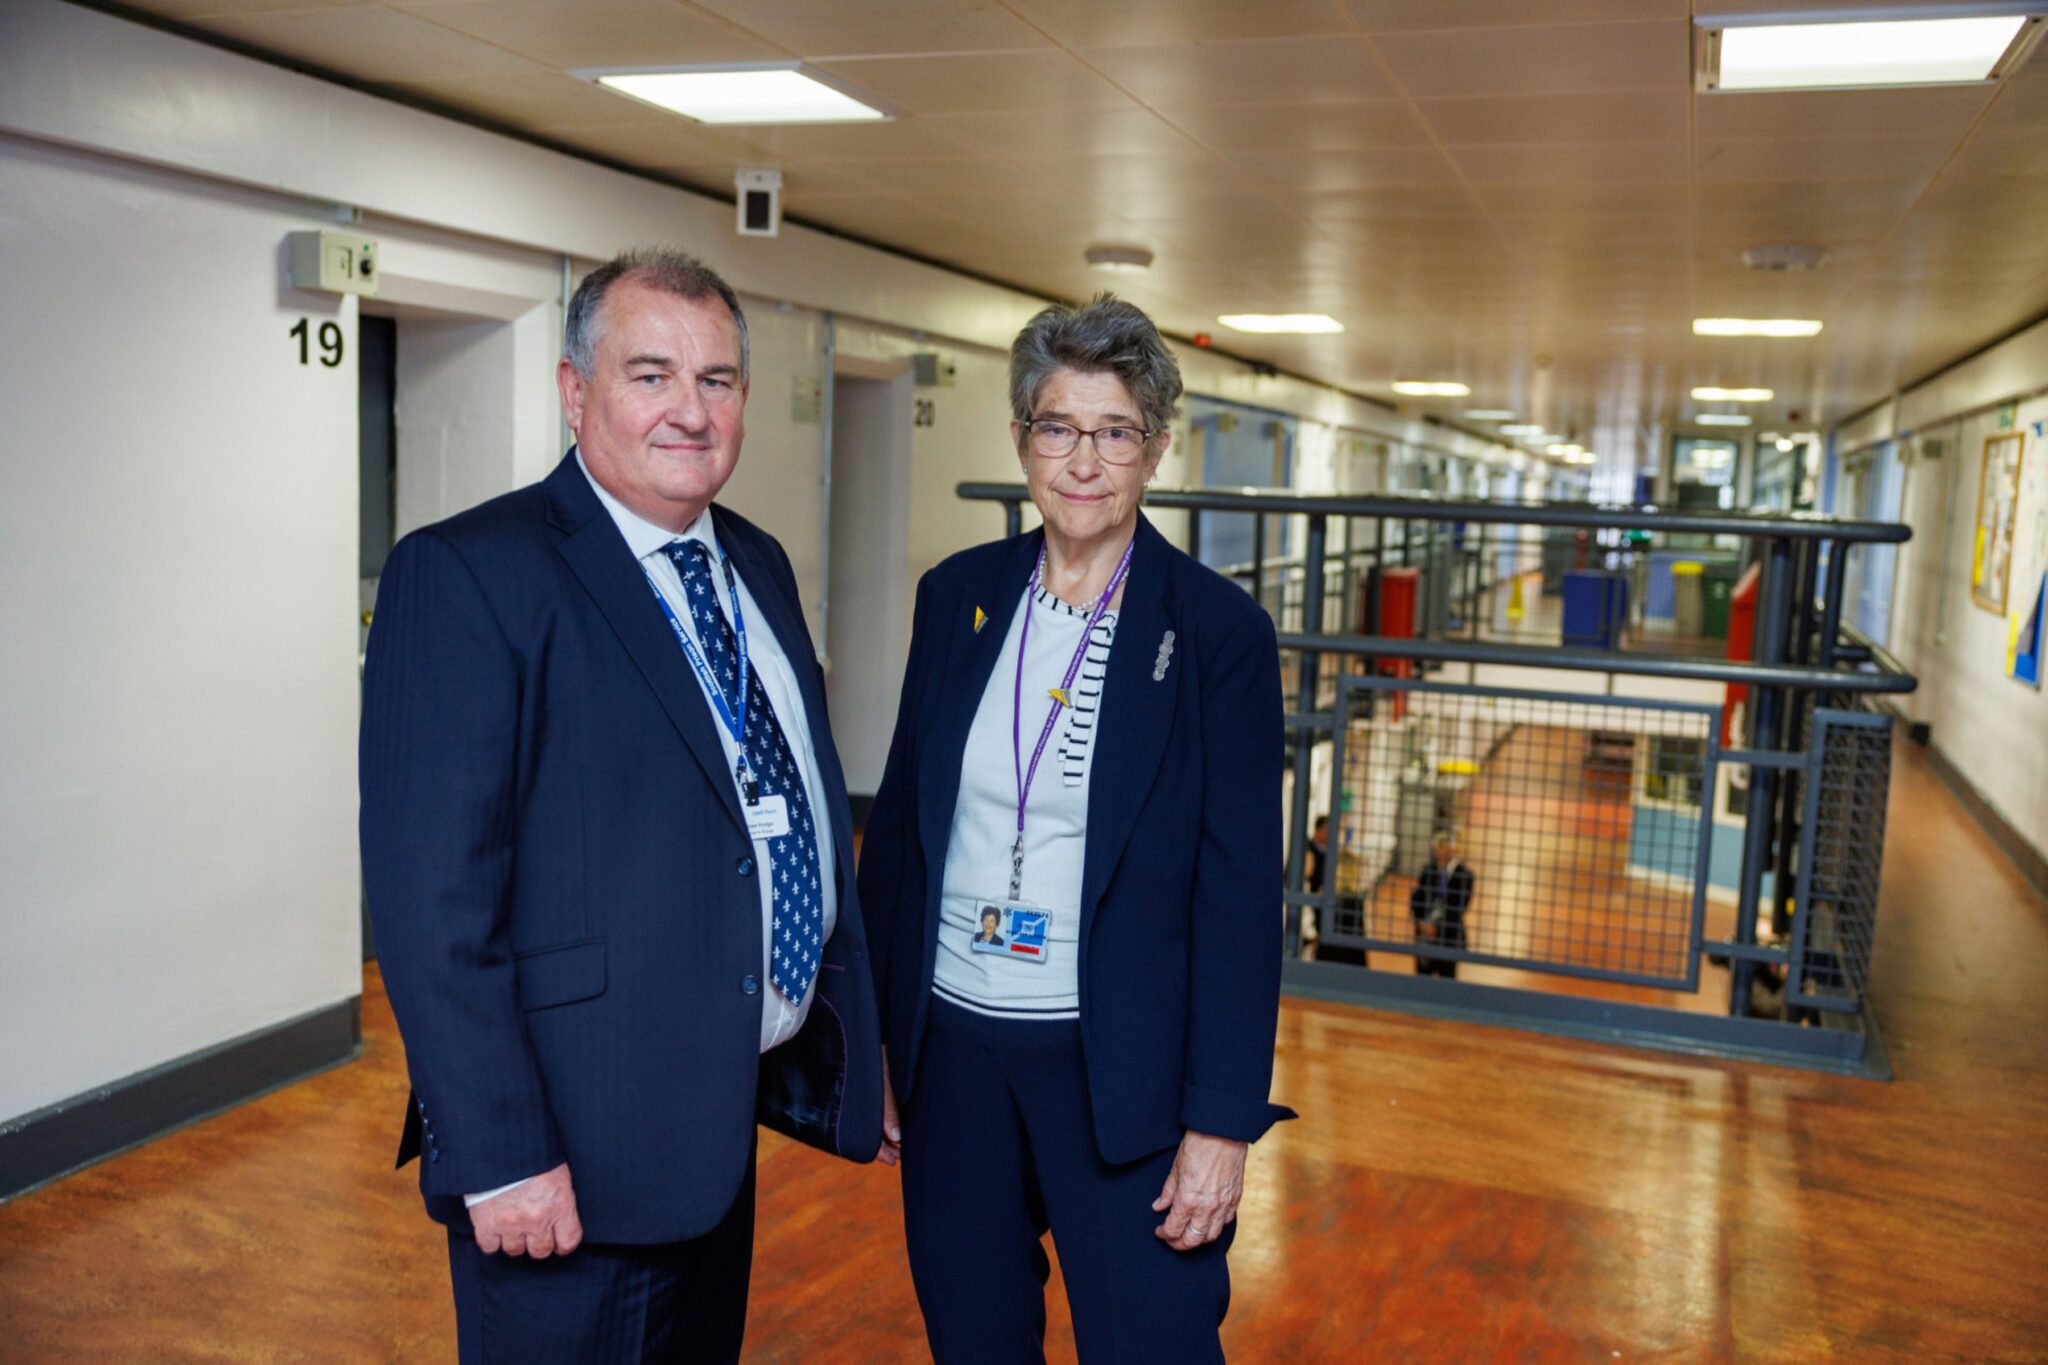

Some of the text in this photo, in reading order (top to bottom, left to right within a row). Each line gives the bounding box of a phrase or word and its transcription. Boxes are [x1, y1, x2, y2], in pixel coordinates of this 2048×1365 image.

[289, 317, 343, 368] 19
[914, 398, 935, 427] 20
[669, 617, 719, 696] Scottish Prison Service
